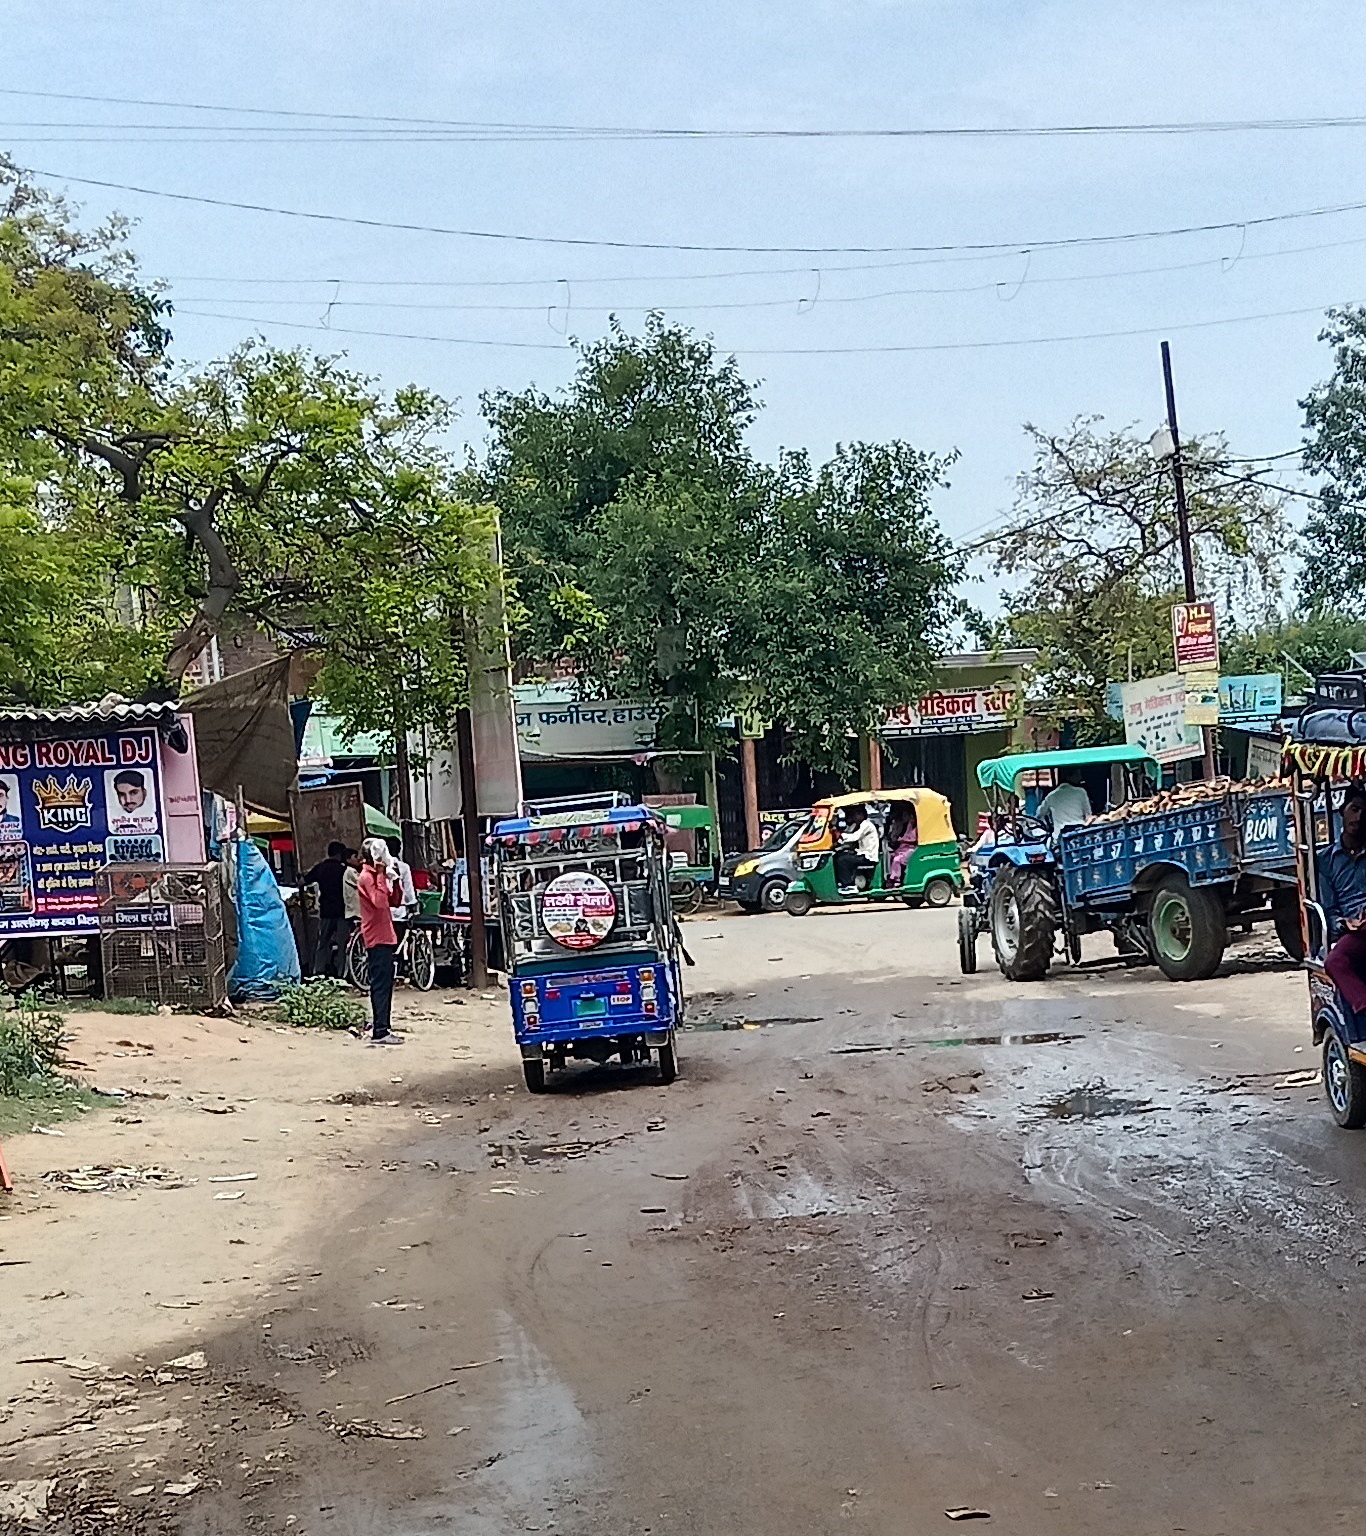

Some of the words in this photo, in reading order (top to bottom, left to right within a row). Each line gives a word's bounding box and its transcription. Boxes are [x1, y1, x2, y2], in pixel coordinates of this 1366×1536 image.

[537, 704, 609, 726] फर्नीचर
[35, 737, 117, 770] ROYAL
[119, 736, 152, 765] DJ
[42, 806, 88, 824] KING
[1244, 816, 1279, 844] BLOW
